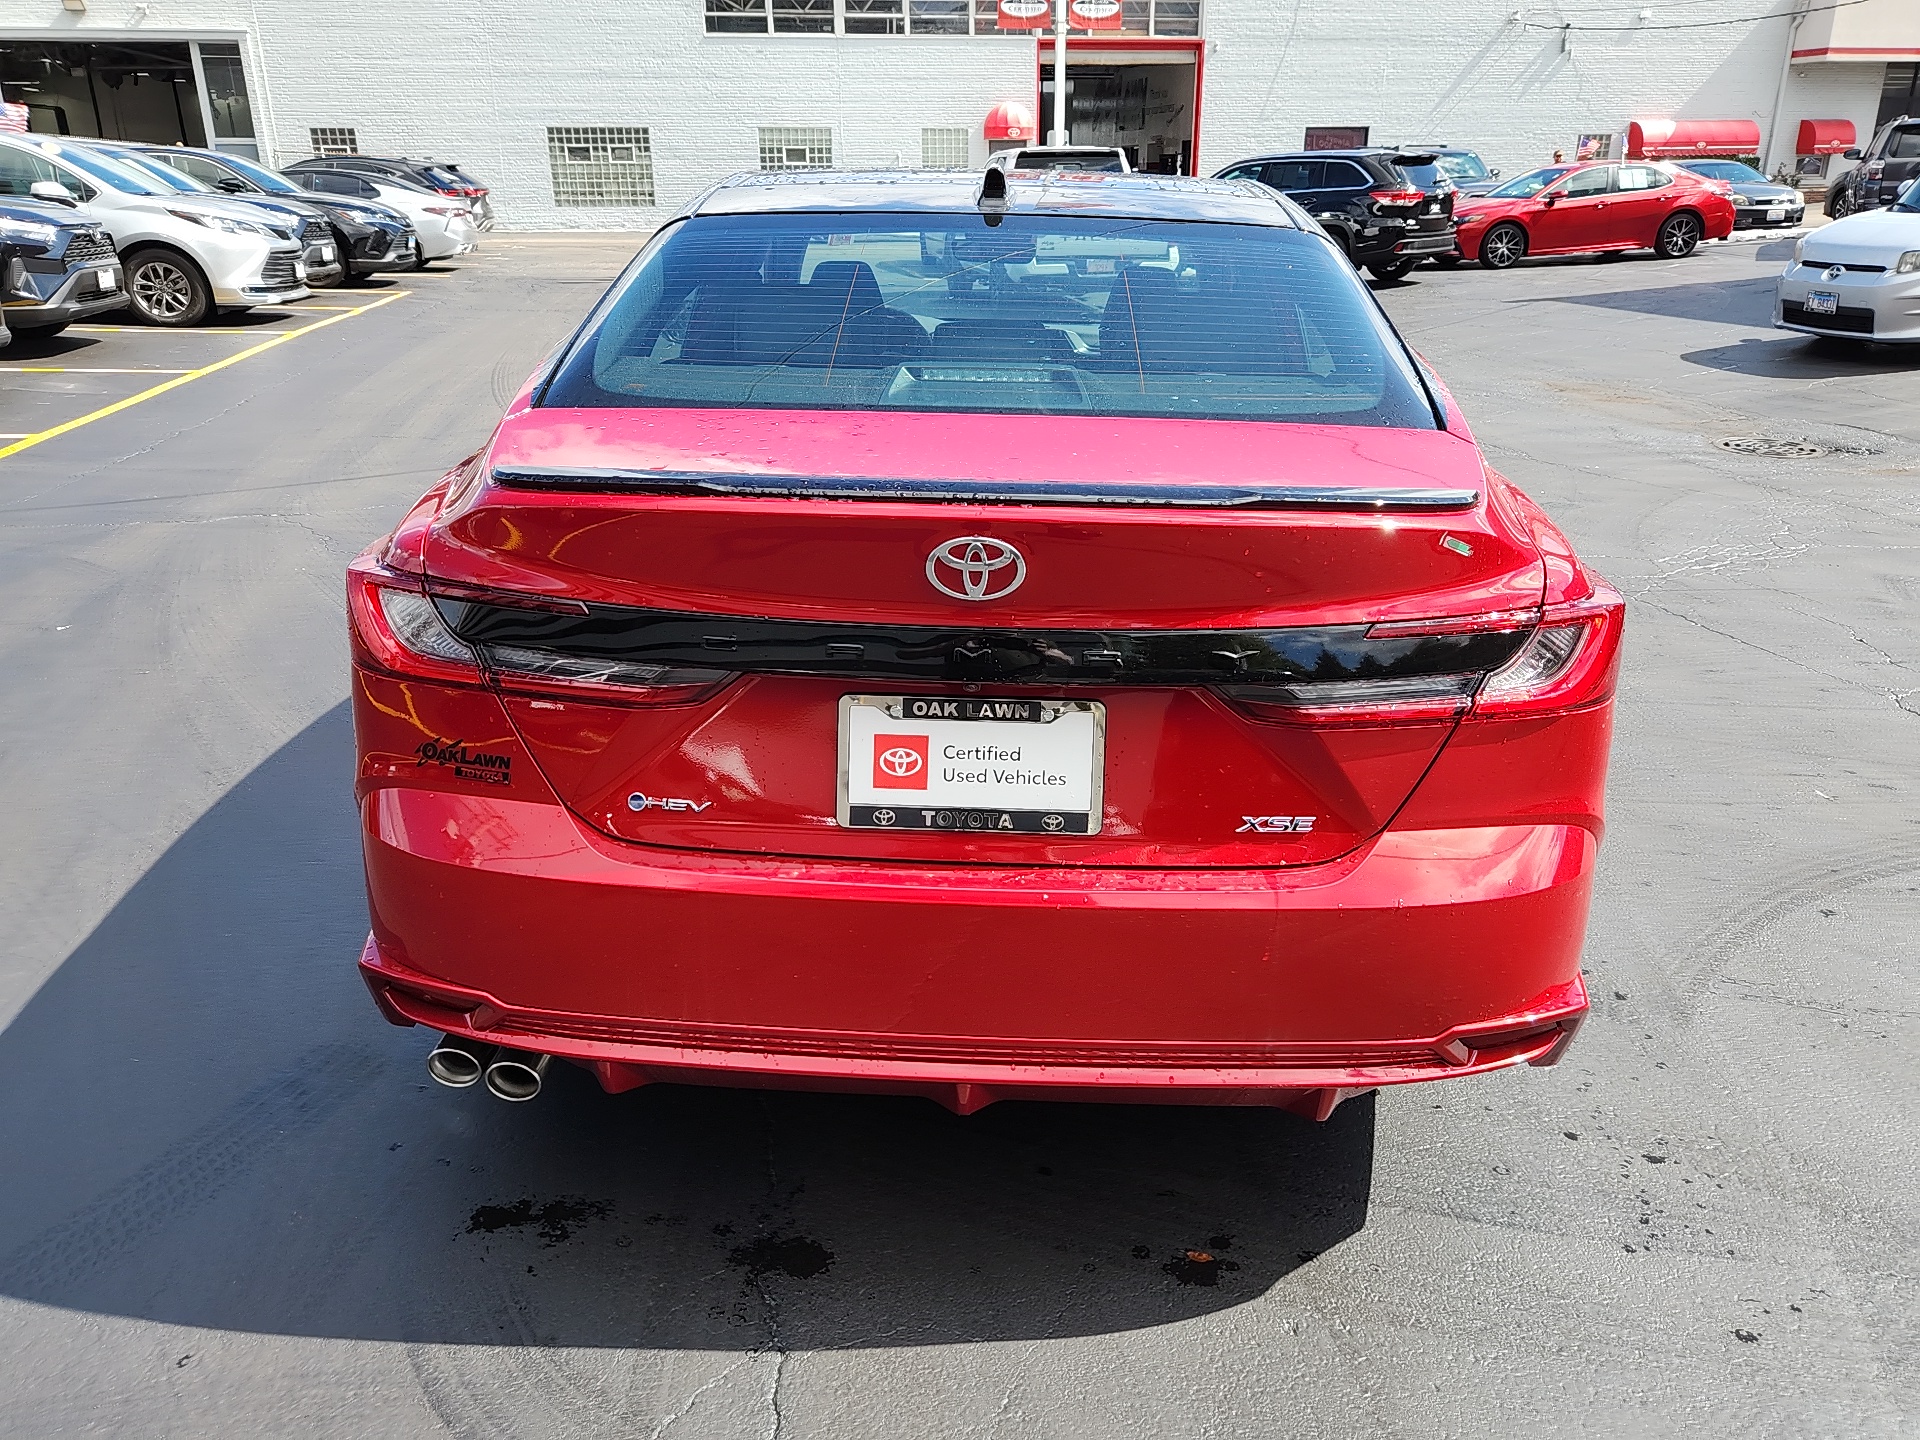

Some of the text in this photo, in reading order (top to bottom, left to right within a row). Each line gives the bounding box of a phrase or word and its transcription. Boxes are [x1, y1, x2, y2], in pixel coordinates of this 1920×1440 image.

[912, 701, 1030, 720] OAK LAWN
[943, 745, 1022, 762] Certified
[461, 768, 504, 781] TOYOTA
[943, 768, 1067, 786] Used Vehicles
[921, 810, 1014, 830] TOYOTA
[1235, 815, 1317, 834] XSE
